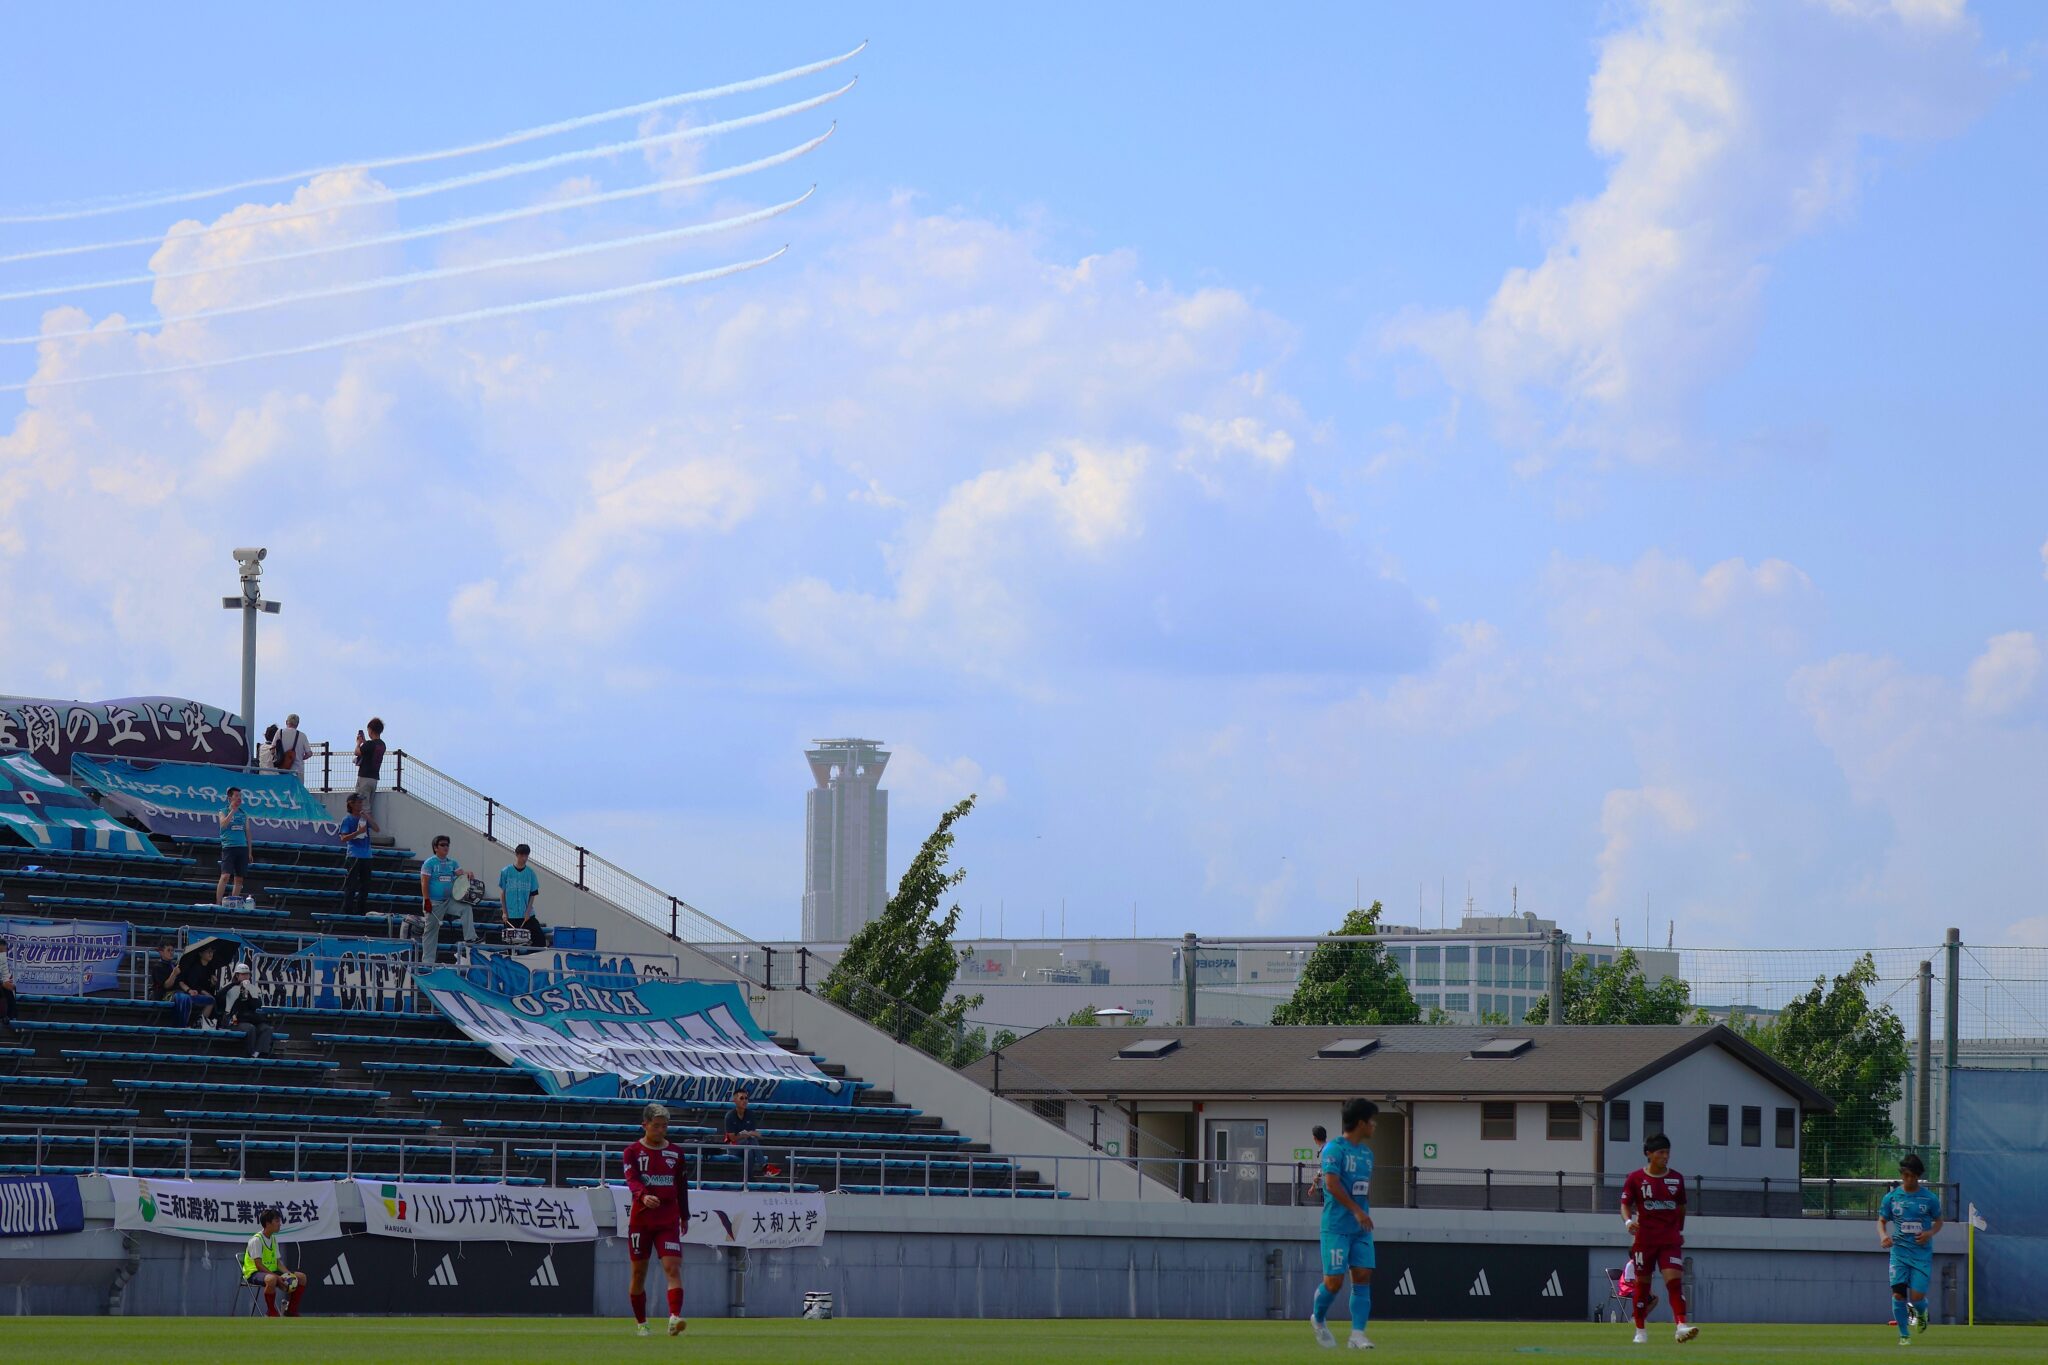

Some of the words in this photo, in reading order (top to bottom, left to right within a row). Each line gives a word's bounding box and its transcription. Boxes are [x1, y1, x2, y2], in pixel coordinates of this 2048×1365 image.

[511, 981, 651, 1017] OSAKA
[638, 1156, 650, 1172] 17
[1345, 1154, 1357, 1172] 16
[1640, 1184, 1653, 1198] 14
[413, 1193, 580, 1230] ハルオカ株式会社
[384, 1224, 413, 1234] HARUOKA
[752, 1211, 818, 1233] 大和大学
[631, 1232, 641, 1249] 17
[1330, 1248, 1344, 1266] 16
[1634, 1251, 1644, 1265] 14
